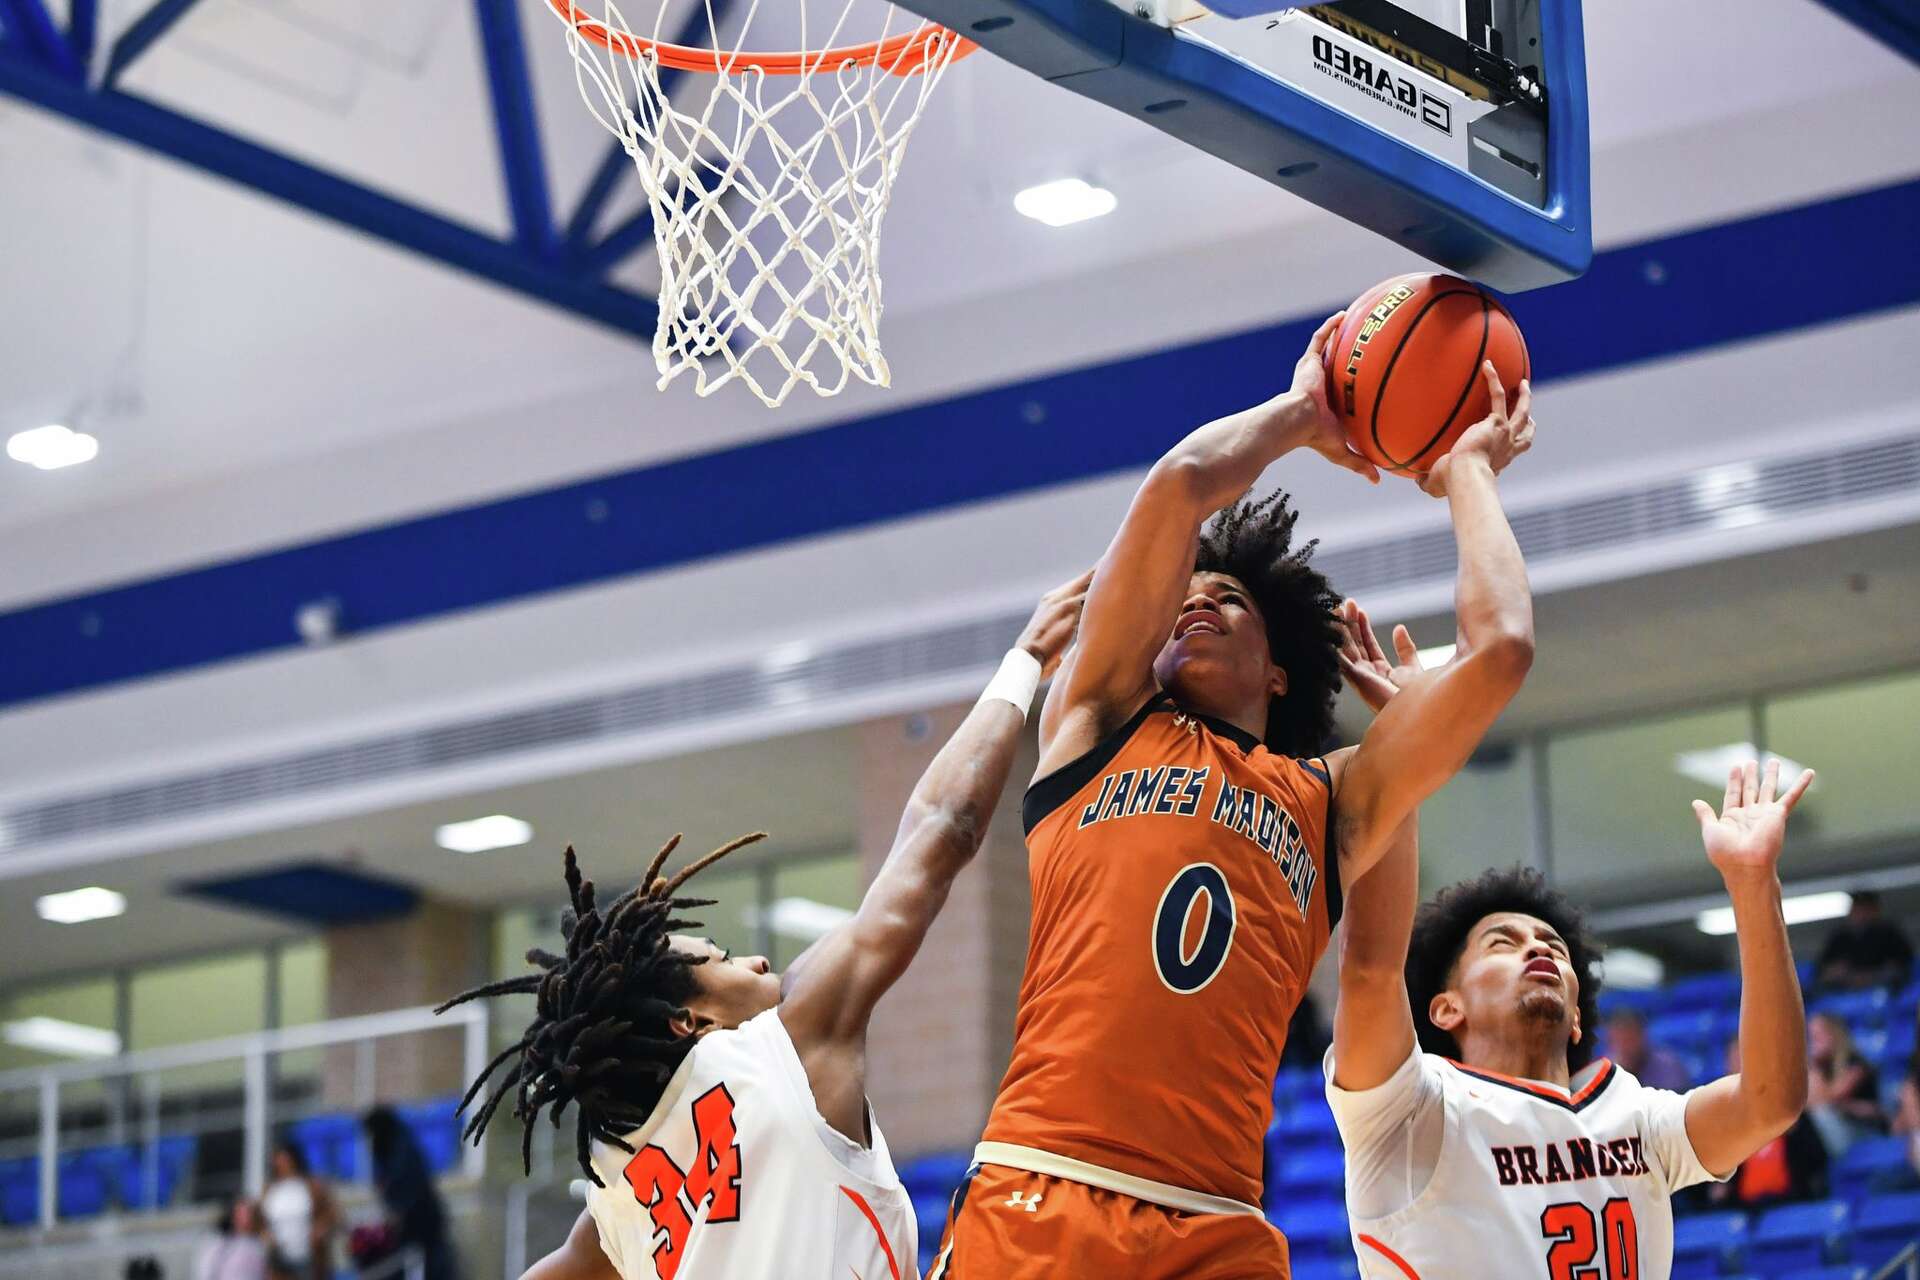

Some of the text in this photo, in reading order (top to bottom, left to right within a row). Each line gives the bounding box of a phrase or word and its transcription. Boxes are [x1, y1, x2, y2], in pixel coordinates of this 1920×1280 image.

[1371, 284, 1415, 325] PRO
[1078, 765, 1317, 923] JAMES MADISON
[1152, 862, 1237, 995] 0
[623, 1081, 742, 1280] 34
[1540, 1197, 1638, 1280] 20
